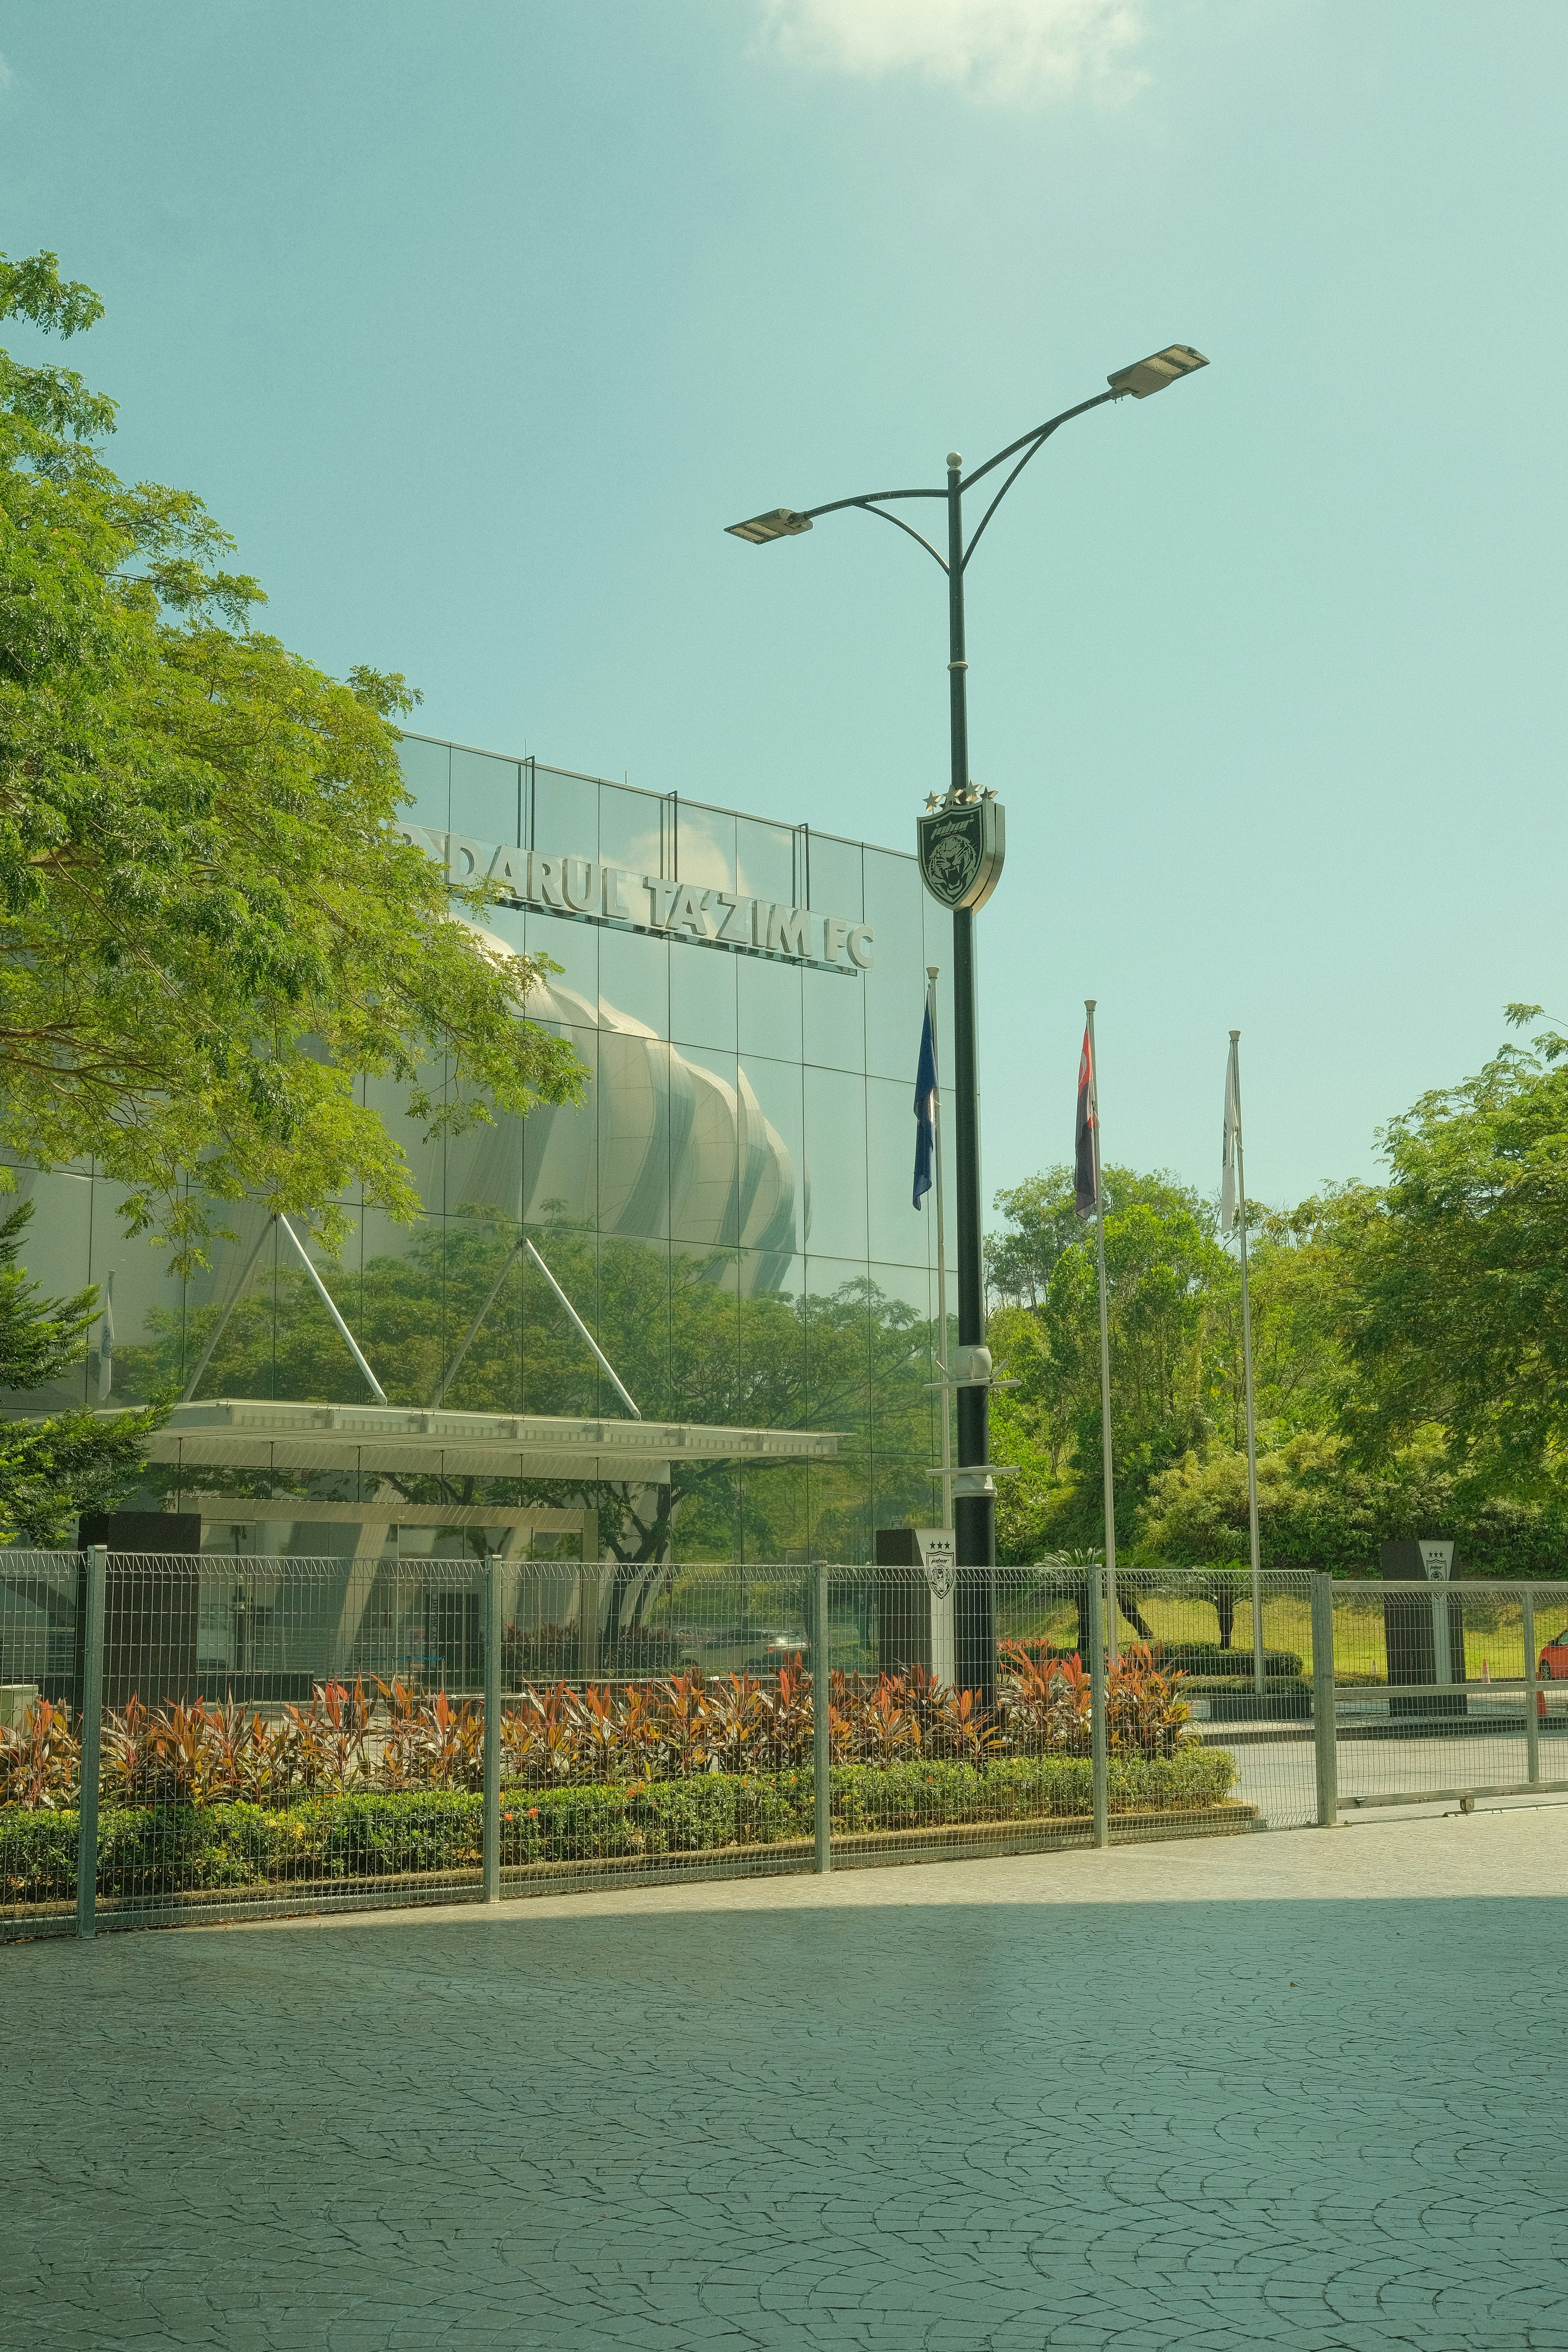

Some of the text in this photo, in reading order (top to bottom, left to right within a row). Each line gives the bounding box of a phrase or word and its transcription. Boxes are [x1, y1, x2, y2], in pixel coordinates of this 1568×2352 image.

[444, 834, 874, 969] DARUL TA'ZIM FC
